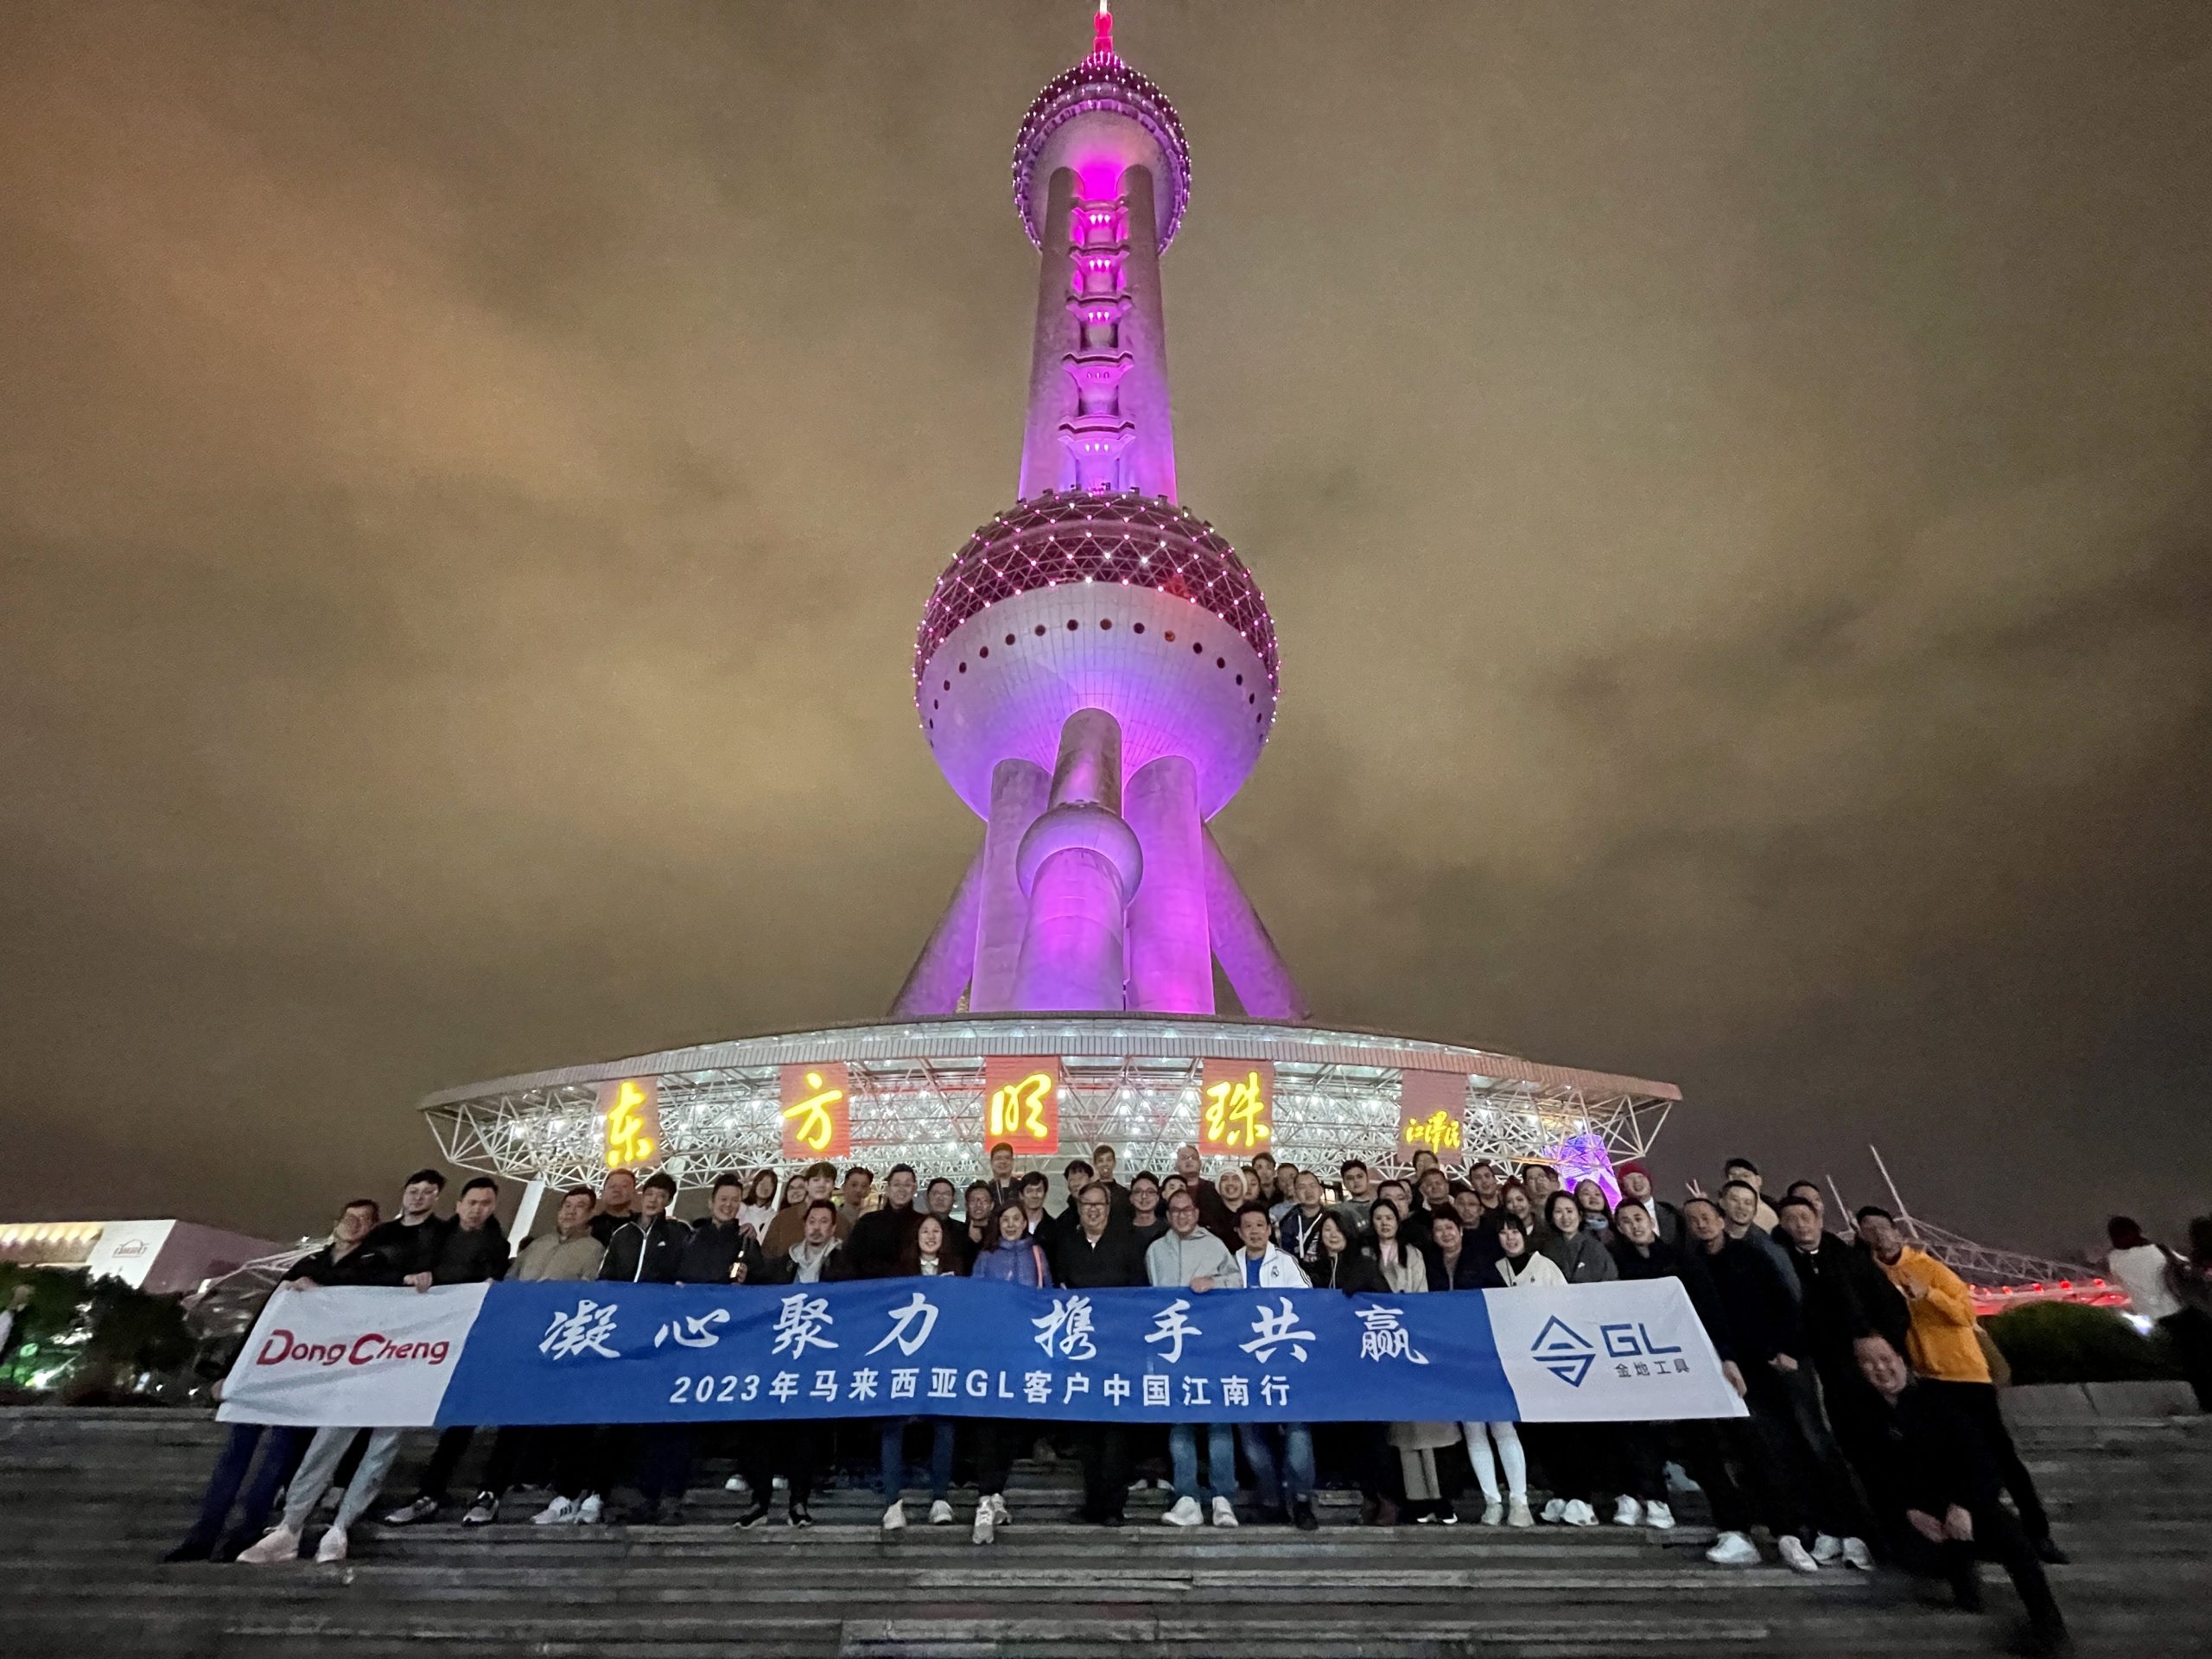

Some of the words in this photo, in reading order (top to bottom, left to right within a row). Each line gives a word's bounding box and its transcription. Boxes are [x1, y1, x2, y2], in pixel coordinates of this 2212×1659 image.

[607, 1071, 1270, 1167] 东方明珠
[538, 1293, 940, 1361] 凝心聚力
[1031, 1295, 1430, 1366] 携手共赢
[1600, 1323, 1682, 1357] GL
[670, 1368, 1291, 1408] 2023年马来西亚GL客户中国江南行
[1614, 1358, 1690, 1378] 金地工具
